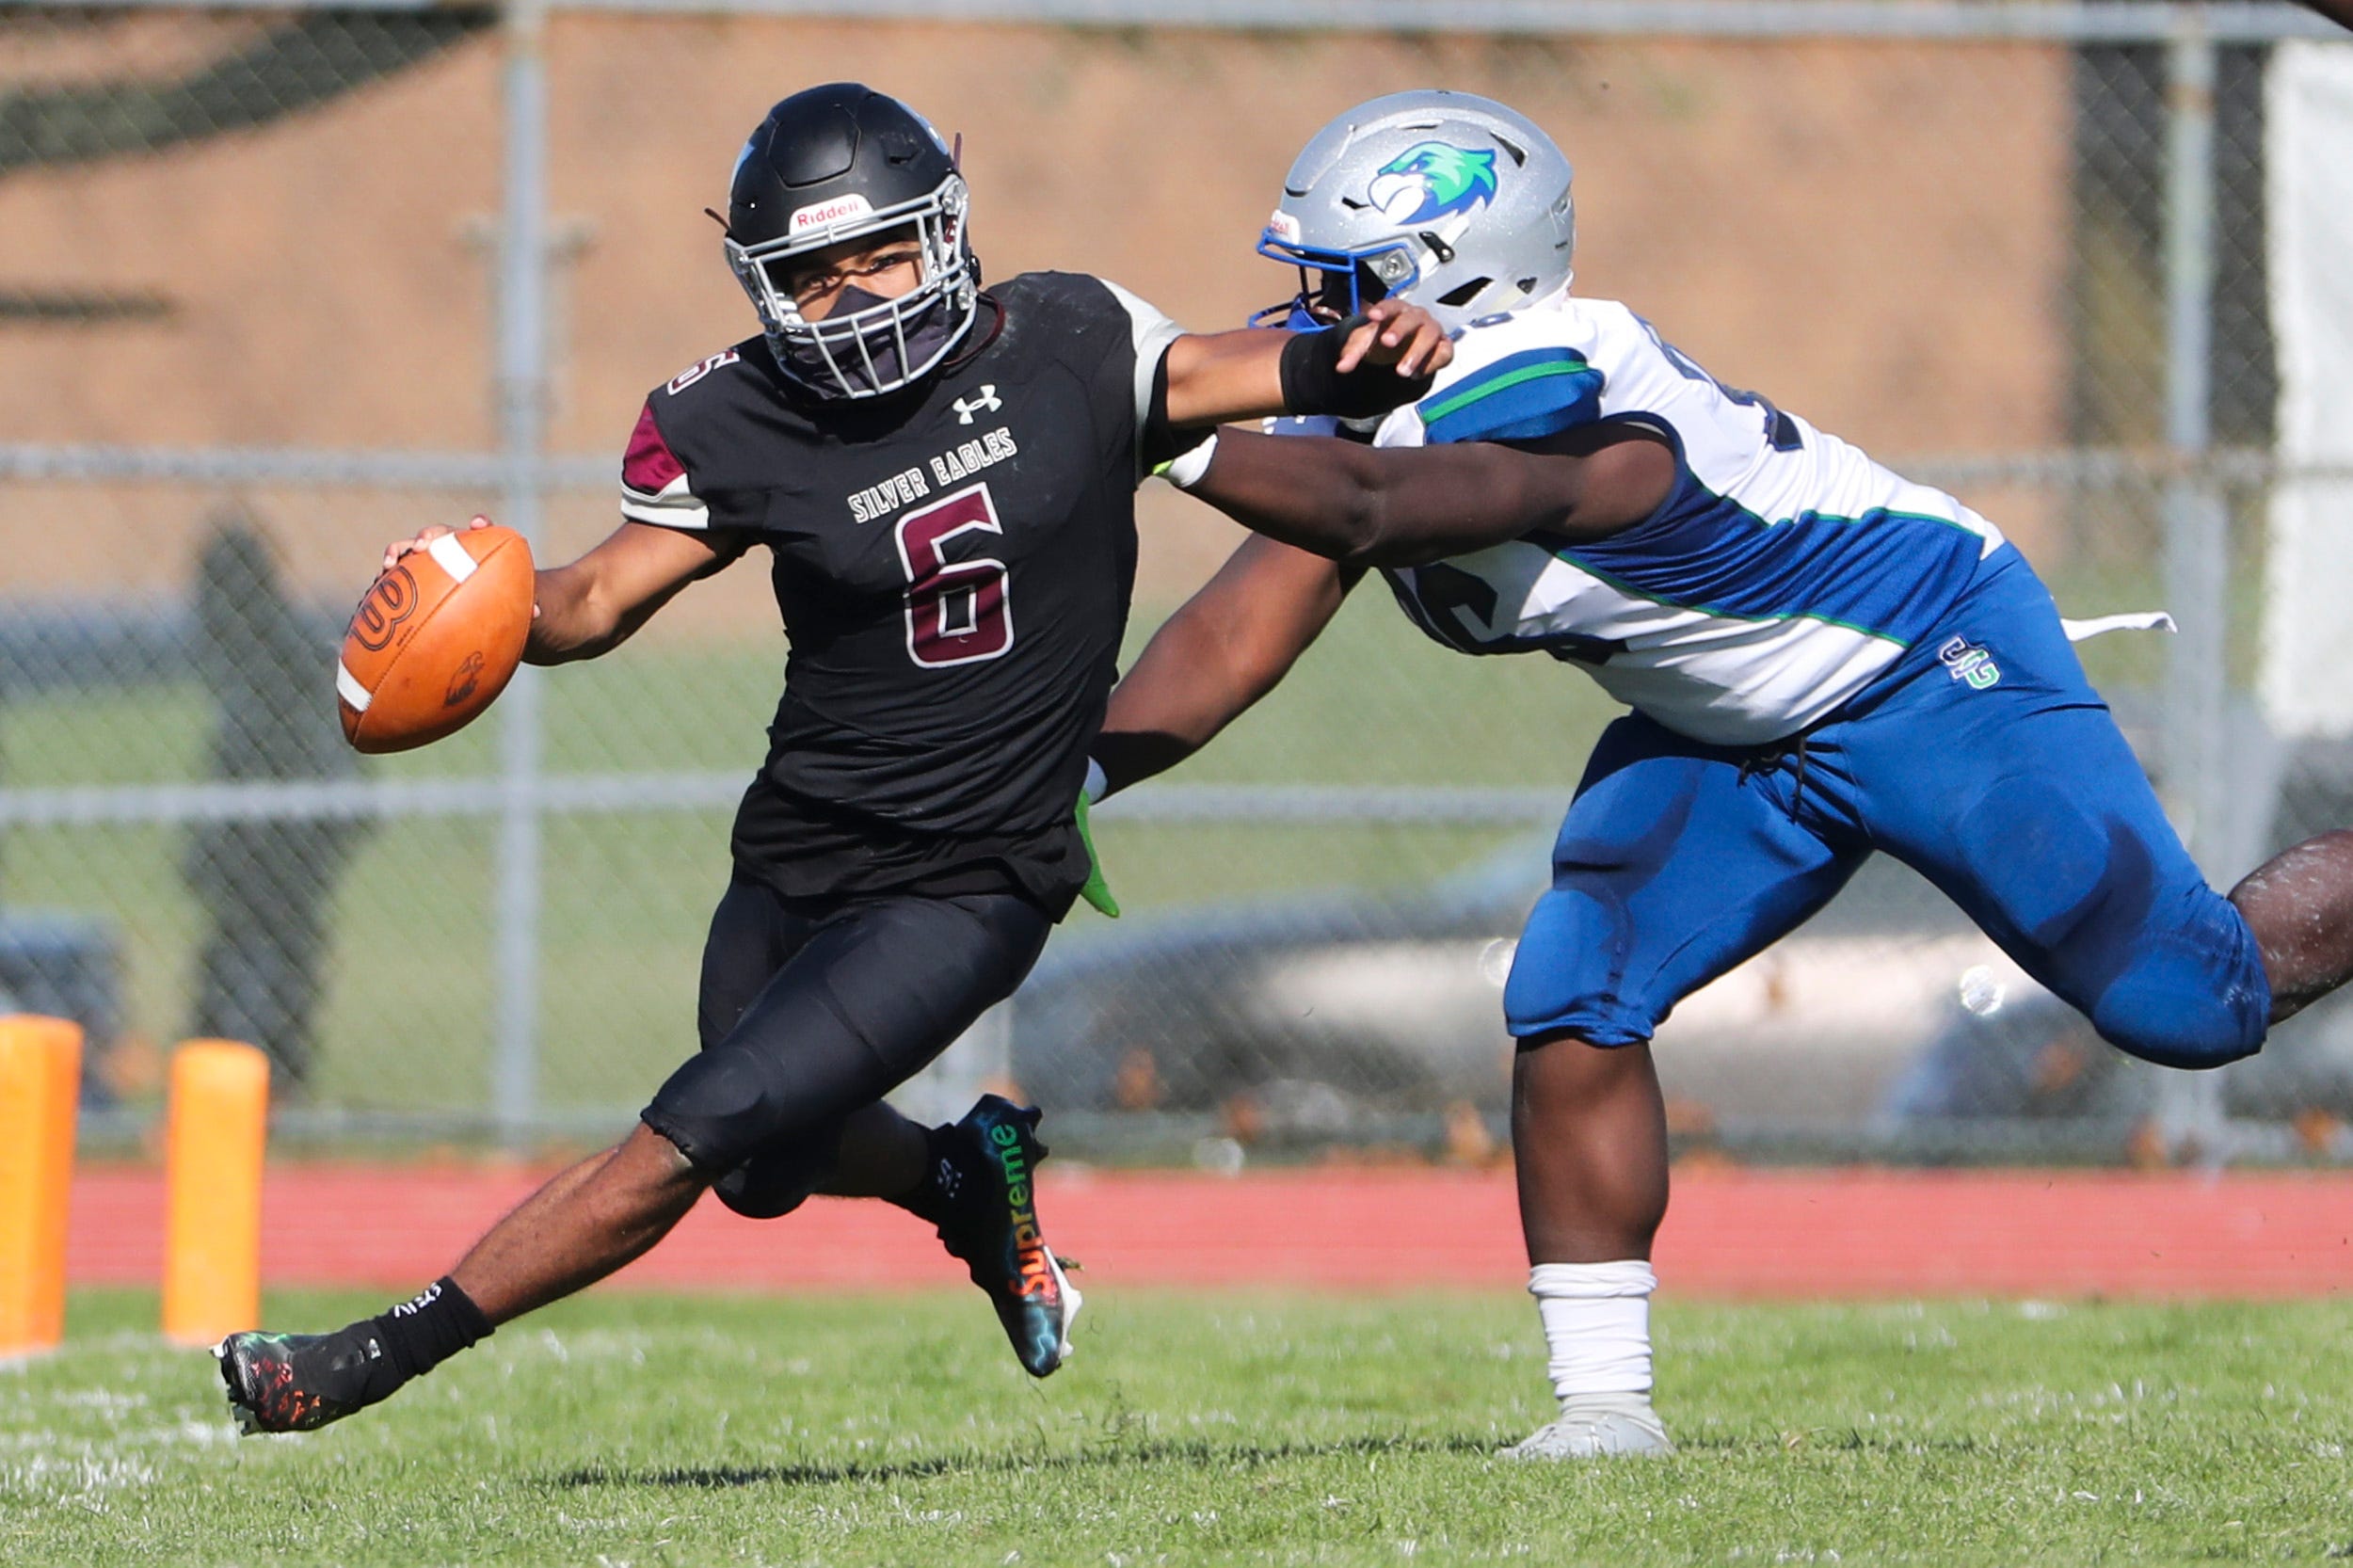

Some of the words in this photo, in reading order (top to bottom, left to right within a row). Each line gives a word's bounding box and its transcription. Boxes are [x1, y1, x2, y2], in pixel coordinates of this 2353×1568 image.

[796, 200, 858, 228] Riddell
[847, 467, 930, 524] SILVER
[929, 426, 1018, 487] EAGLES
[894, 481, 1015, 669] 6
[990, 1123, 1054, 1298] Supreme
